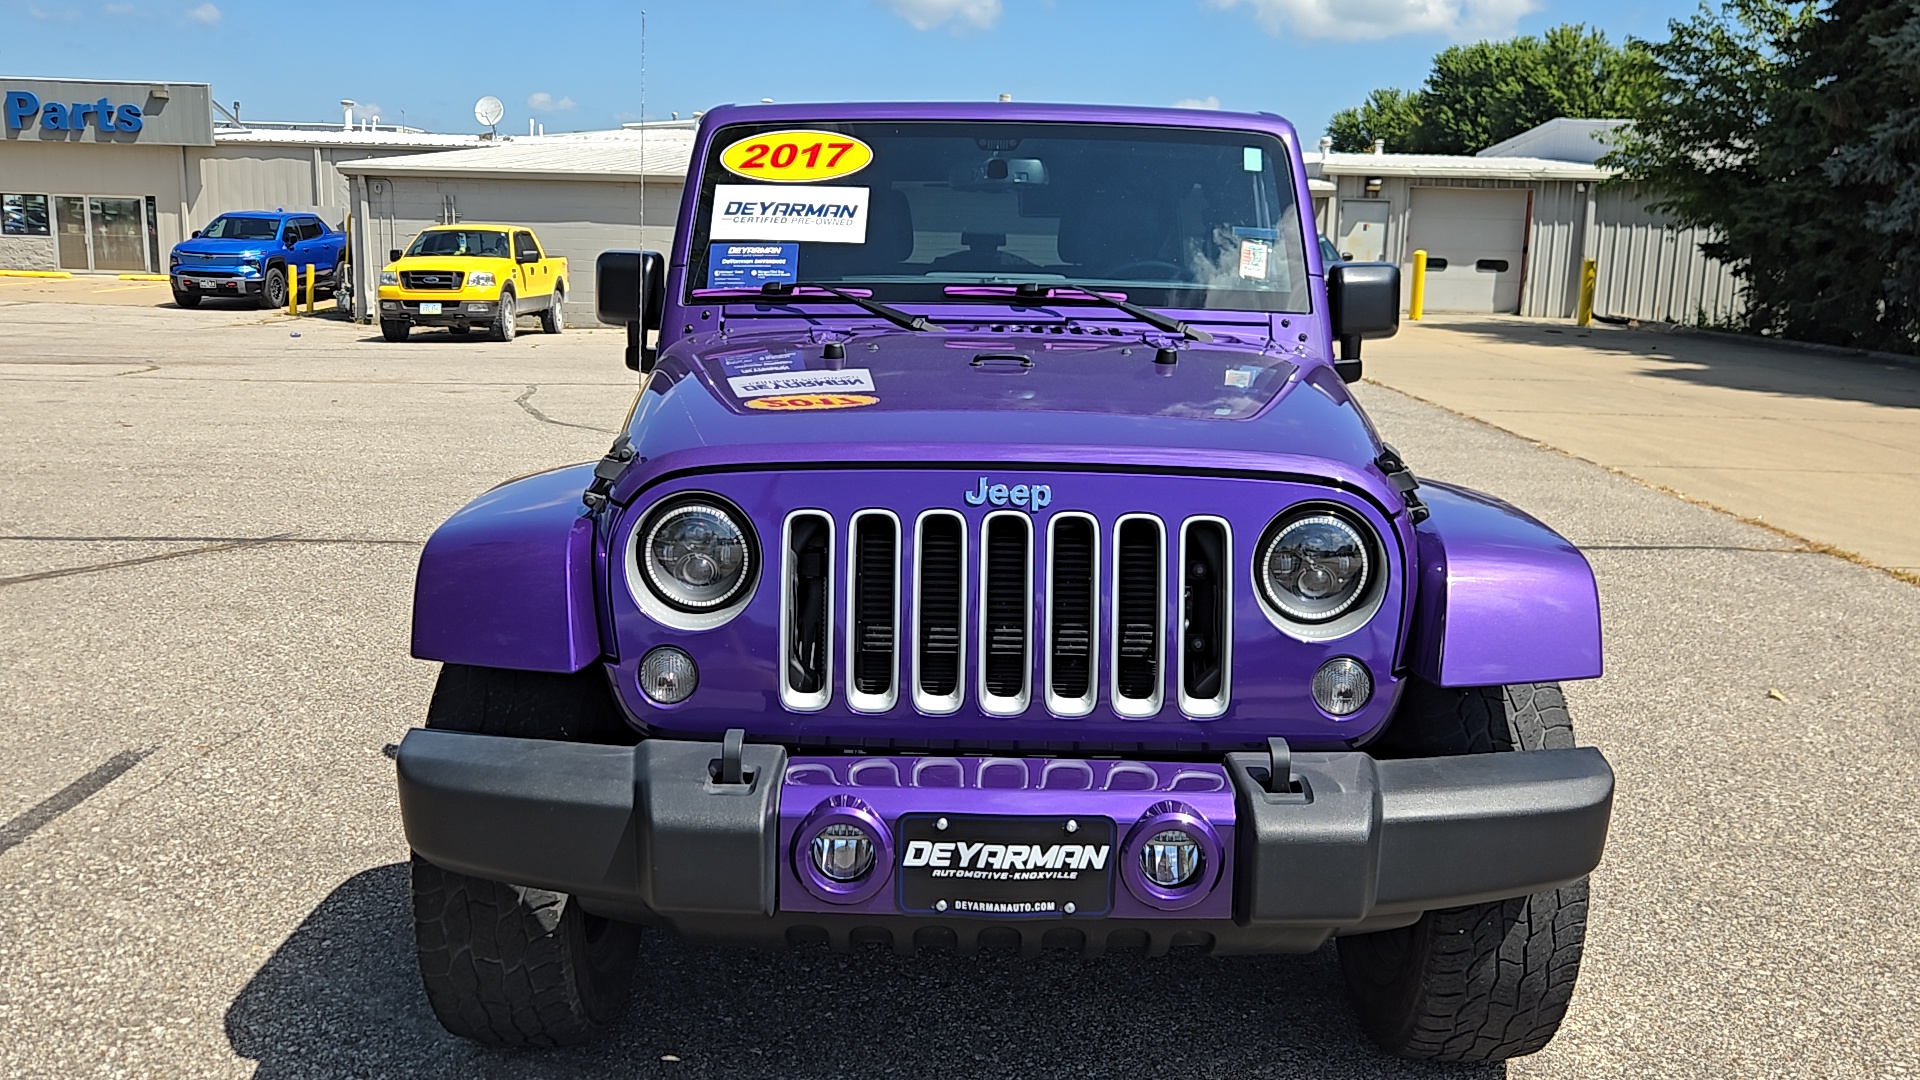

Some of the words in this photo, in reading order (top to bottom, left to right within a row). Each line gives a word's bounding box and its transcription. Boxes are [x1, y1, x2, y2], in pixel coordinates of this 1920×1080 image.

[6, 90, 143, 132] Parts
[737, 142, 855, 171] 2017
[723, 201, 859, 219] DEYARMAN
[732, 216, 787, 224] CERTIFIED
[790, 217, 854, 226] PRE-OWNED
[964, 476, 1052, 513] Jeep
[902, 840, 1110, 871] DEYARMAN
[931, 869, 1079, 880] AUTOMOTIVE-KNOXVILLE
[954, 900, 1056, 913] DEYARMANAUTO.COM
